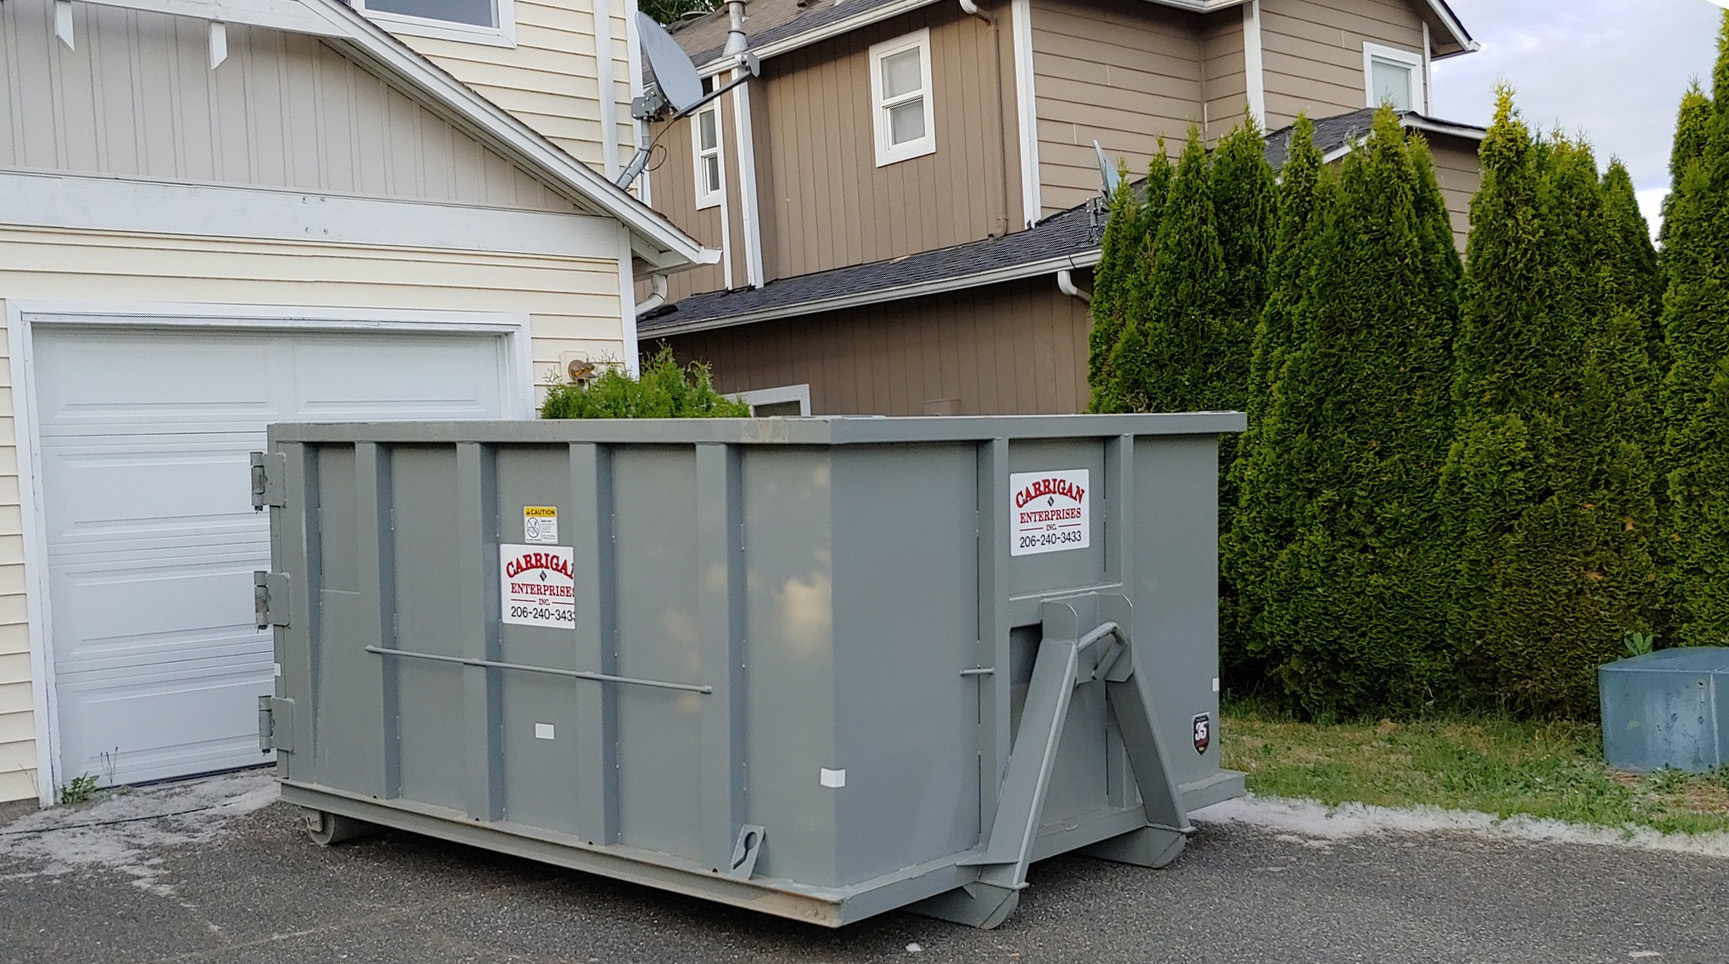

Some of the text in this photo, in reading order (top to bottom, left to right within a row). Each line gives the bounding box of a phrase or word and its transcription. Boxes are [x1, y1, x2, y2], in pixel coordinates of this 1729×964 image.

[1015, 478, 1085, 508] CARRIGAN
[1019, 507, 1081, 524] ENTERPRISES
[1019, 530, 1082, 548] 206-240-3433
[1194, 720, 1209, 741] 35
